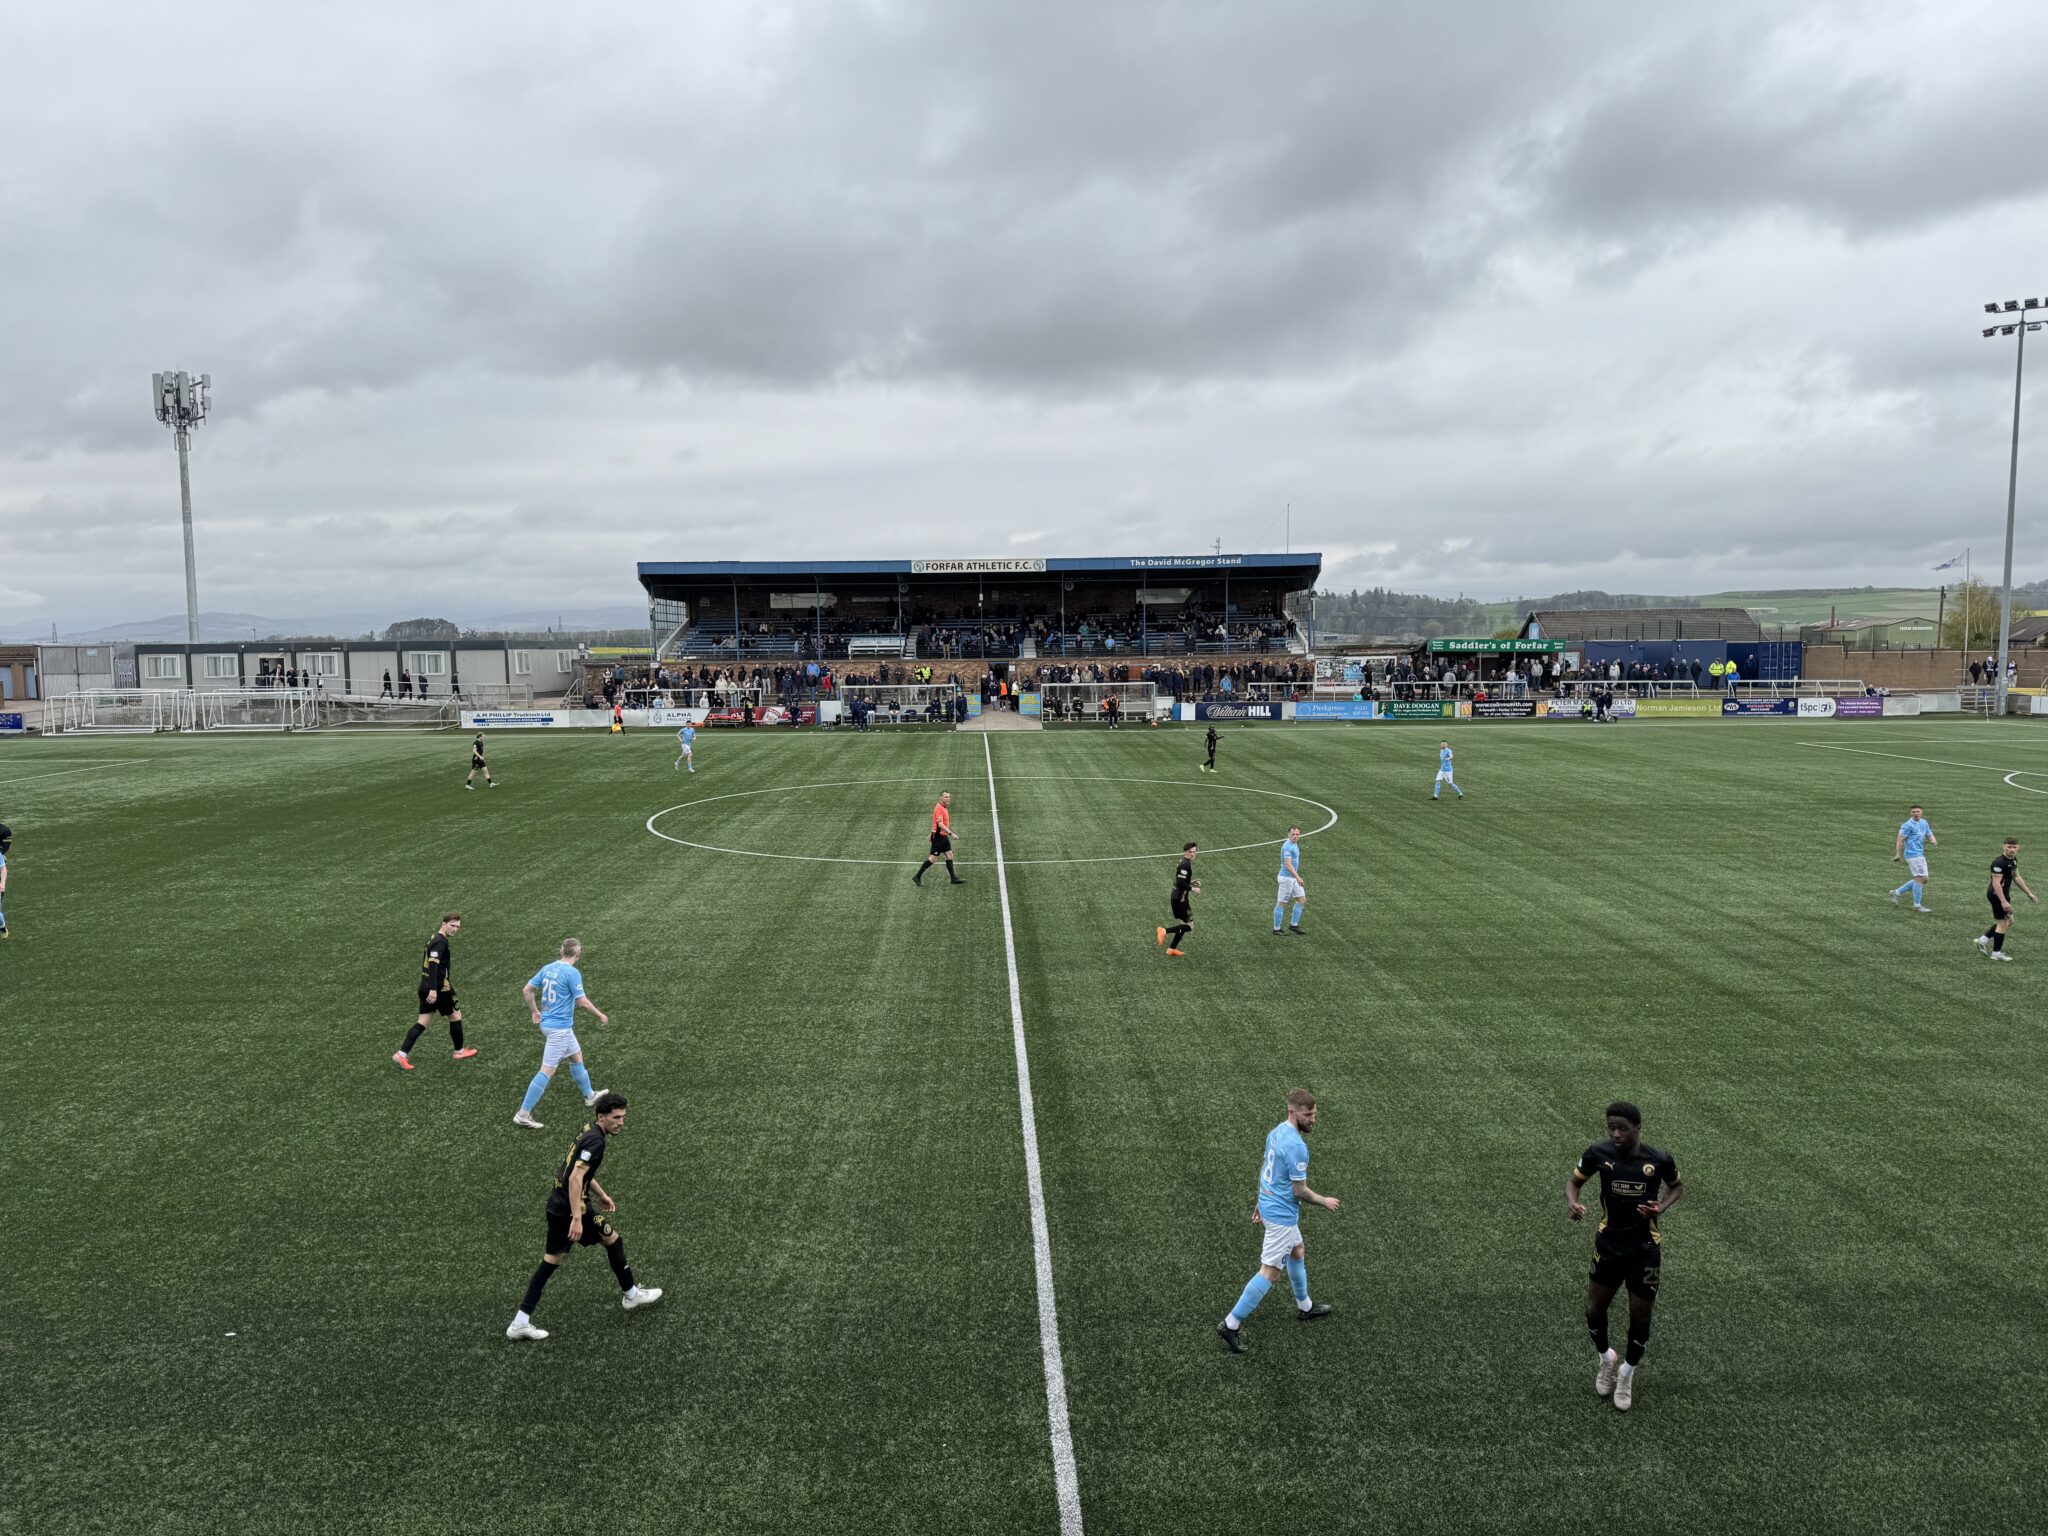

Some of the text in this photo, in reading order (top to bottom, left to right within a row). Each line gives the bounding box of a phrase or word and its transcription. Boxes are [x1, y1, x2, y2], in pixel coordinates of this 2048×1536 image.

[925, 561, 1031, 571] FORFAR ATHLETIC F.C.
[1148, 558, 1172, 566] David
[1174, 558, 1215, 567] McGregor
[1217, 557, 1242, 565] Stand
[1449, 641, 1496, 650] Saddler's
[1500, 641, 1510, 649] of
[1515, 641, 1549, 649] Forfar
[1206, 704, 1271, 718] William HILL
[1669, 704, 1706, 712] Jamieson
[1708, 704, 1722, 712] Ltd
